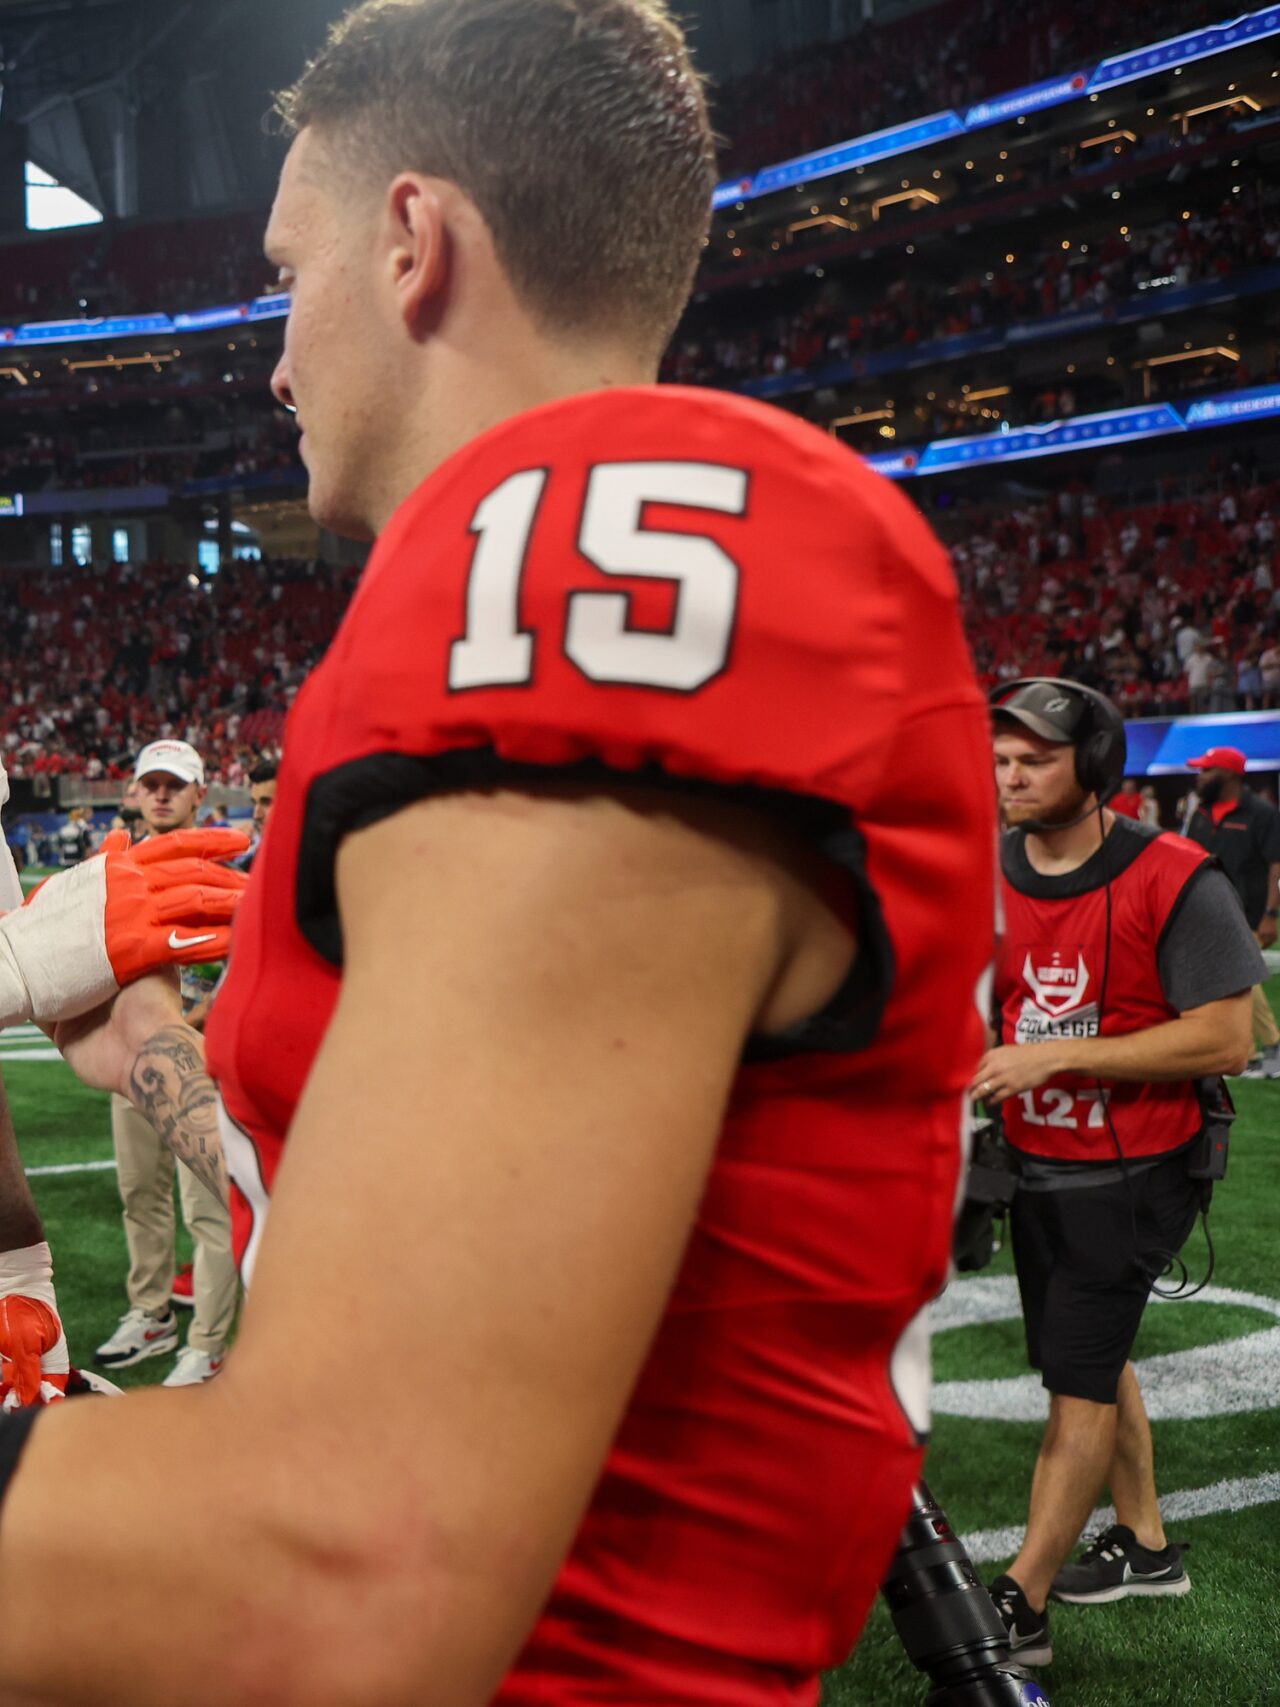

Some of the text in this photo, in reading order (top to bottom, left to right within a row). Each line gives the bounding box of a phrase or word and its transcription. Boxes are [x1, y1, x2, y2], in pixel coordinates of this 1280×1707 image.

[447, 459, 751, 695] 15
[1017, 1016, 1099, 1038] COLLEGE
[1018, 1088, 1111, 1129] 127
